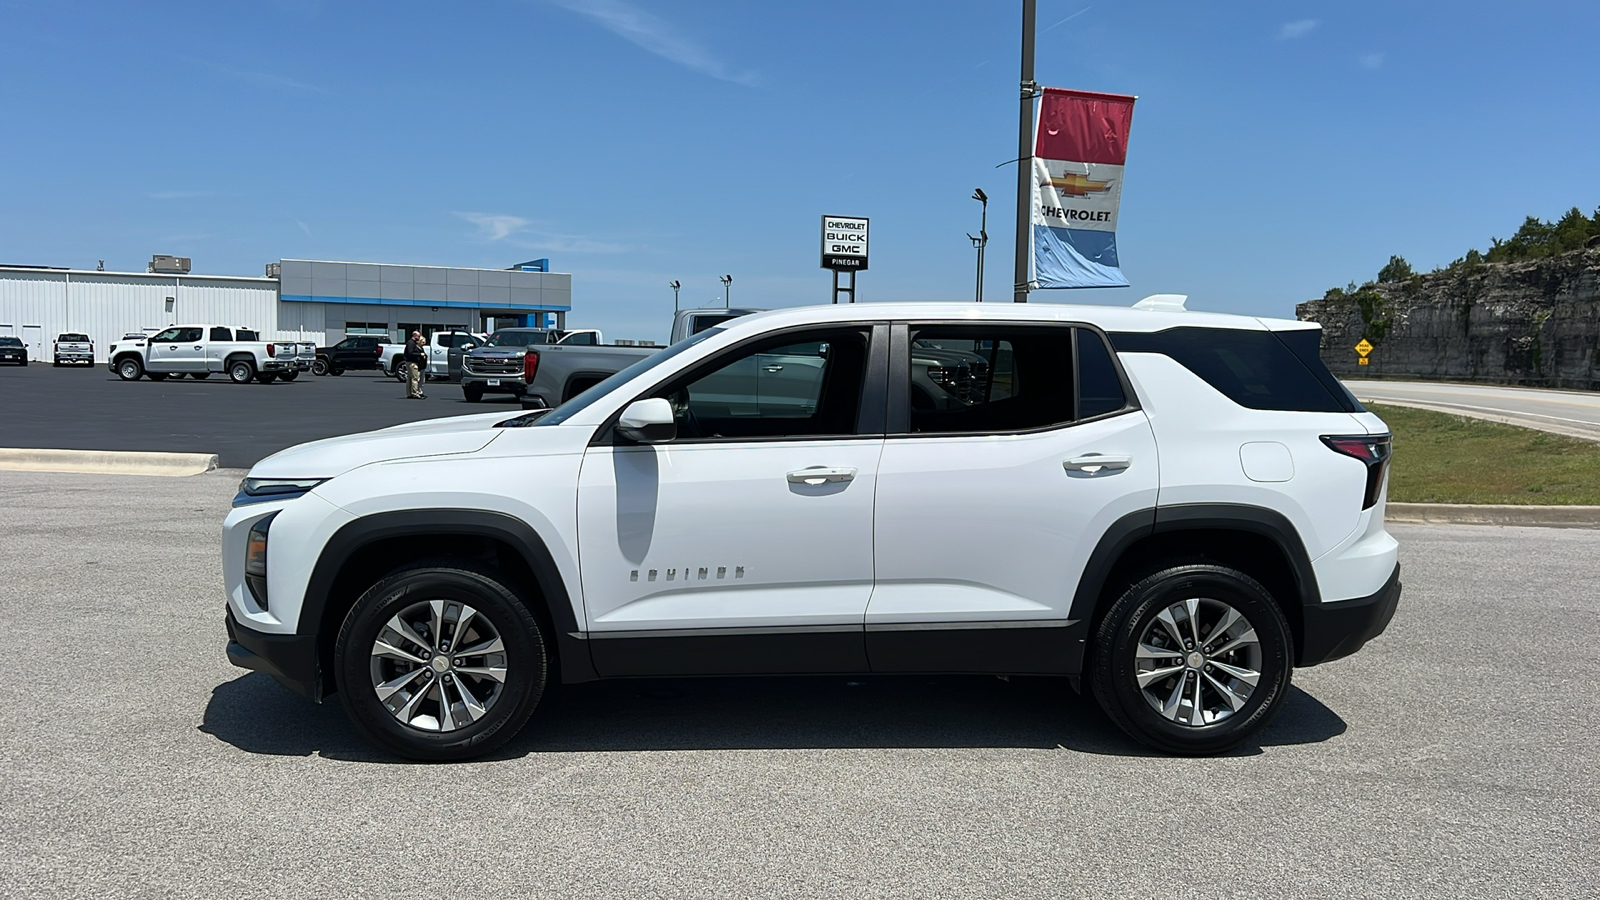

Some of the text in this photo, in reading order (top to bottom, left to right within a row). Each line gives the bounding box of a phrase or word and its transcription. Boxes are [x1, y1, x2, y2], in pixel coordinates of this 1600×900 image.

[827, 221, 866, 230] CHEVROLET
[827, 232, 866, 242] BUICK
[832, 244, 860, 253] GMC
[831, 258, 860, 266] PINEGAR
[630, 566, 745, 581] EQUINOX
